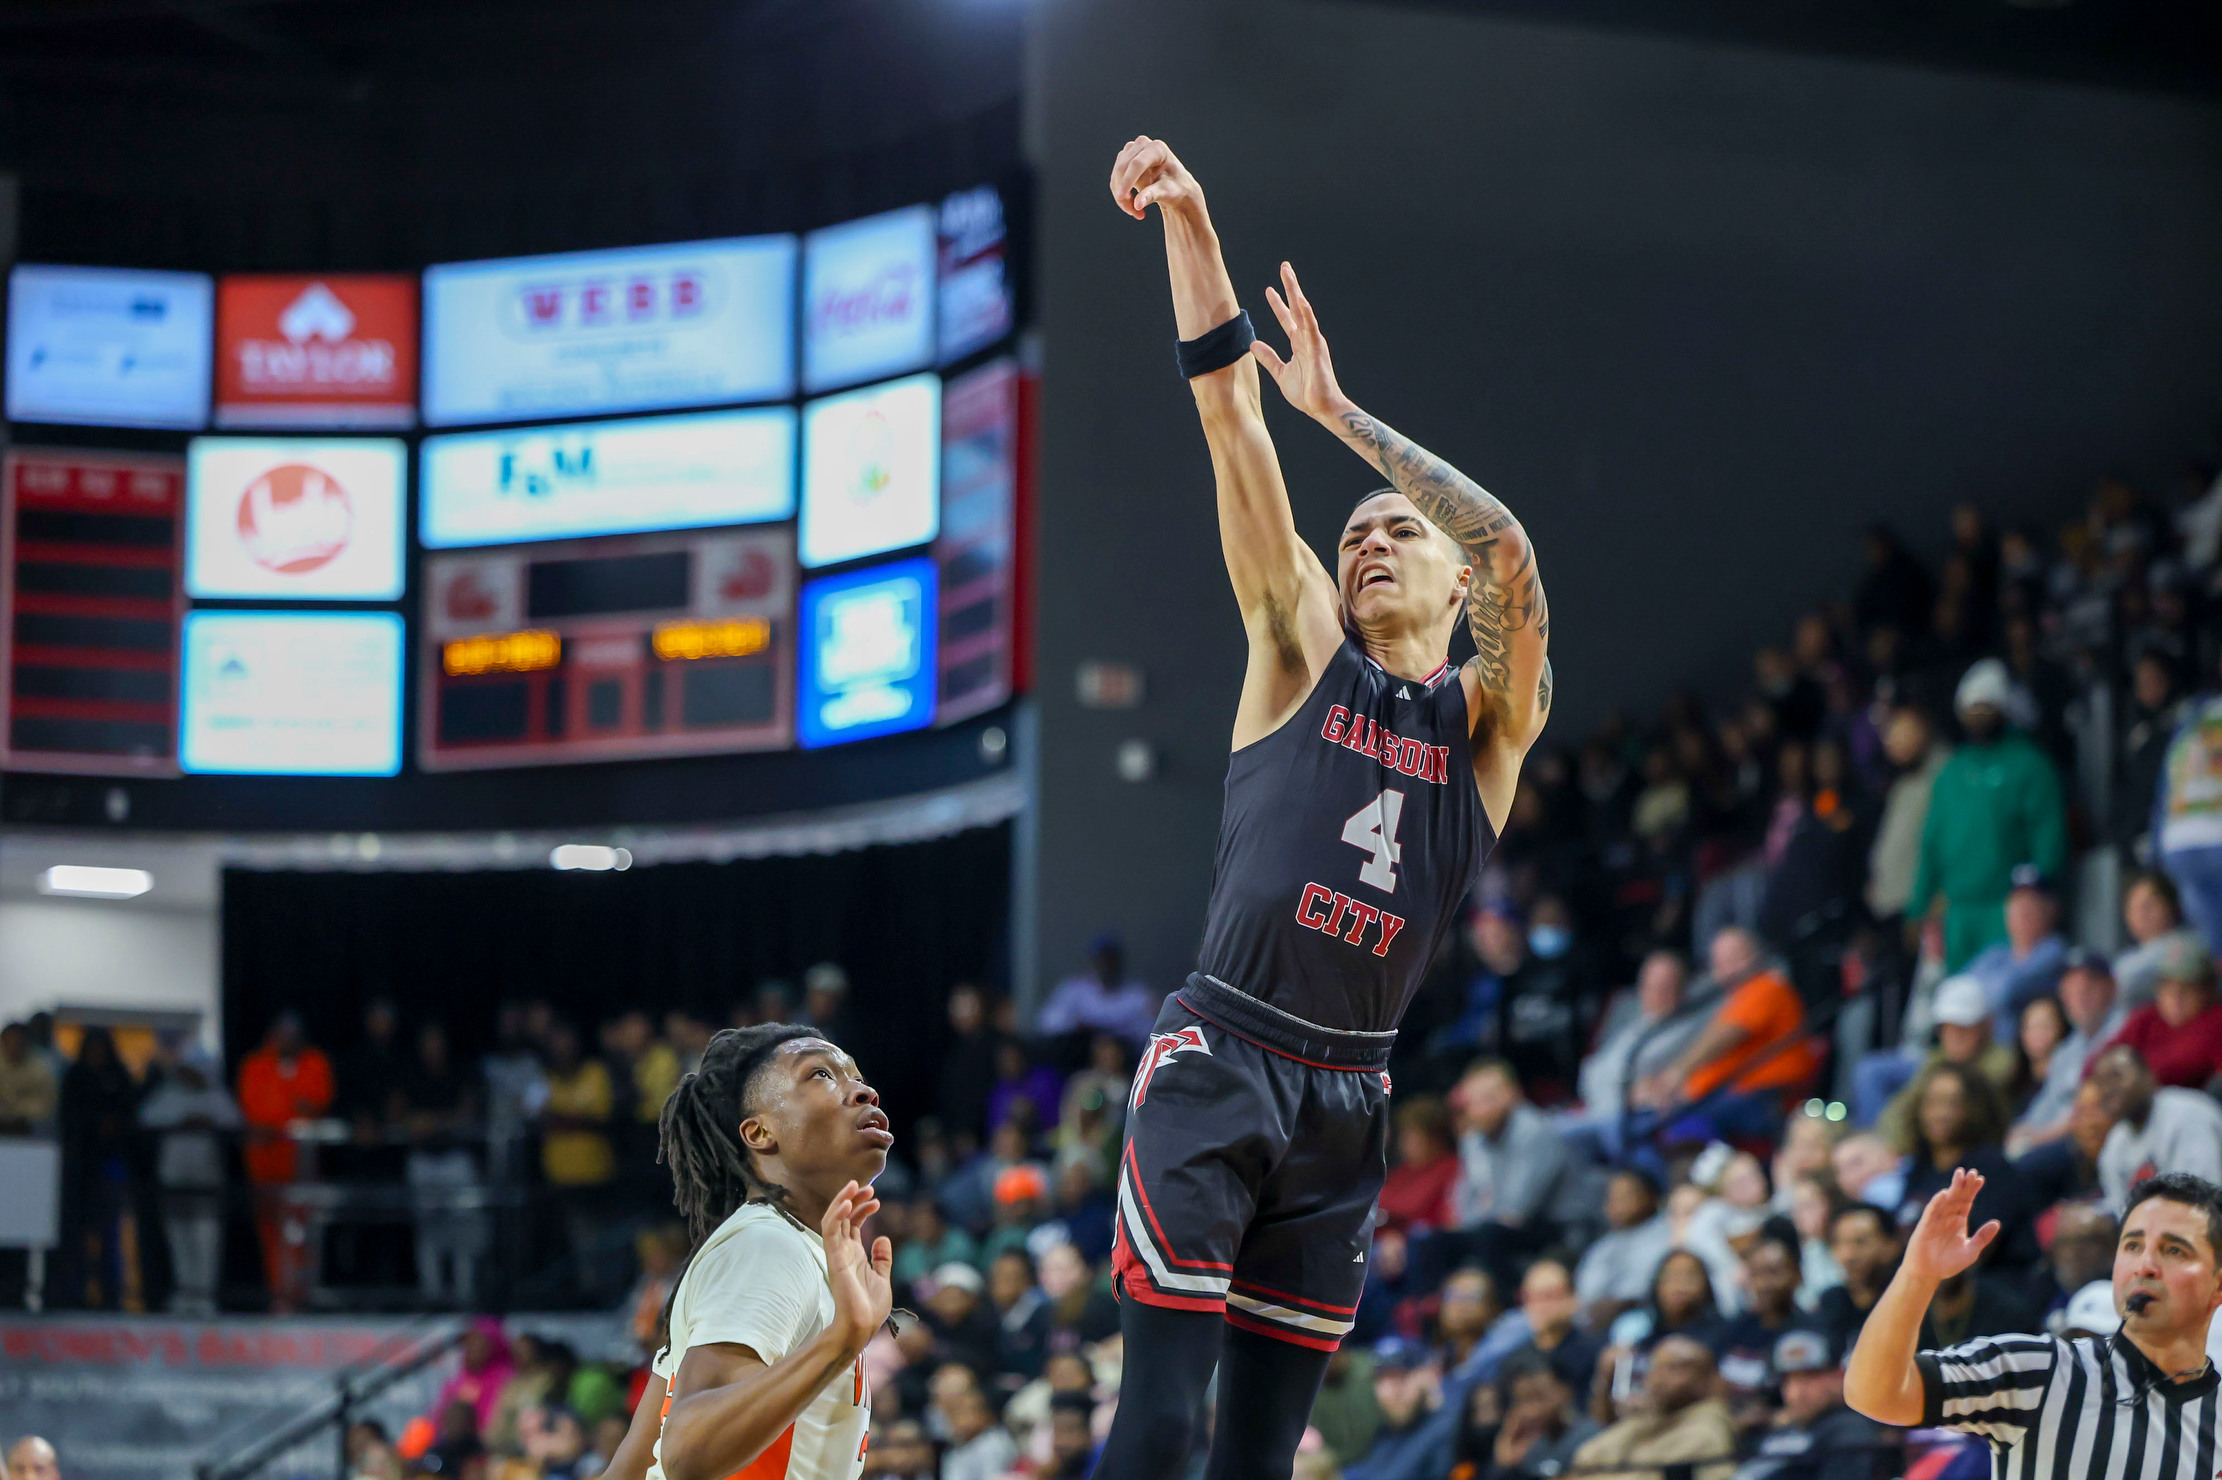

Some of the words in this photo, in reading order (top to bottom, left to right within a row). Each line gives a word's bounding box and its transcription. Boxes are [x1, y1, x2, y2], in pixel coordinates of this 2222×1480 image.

[521, 267, 706, 332] WEBB
[1341, 788, 1406, 894] 4
[1296, 881, 1405, 958] CITY
